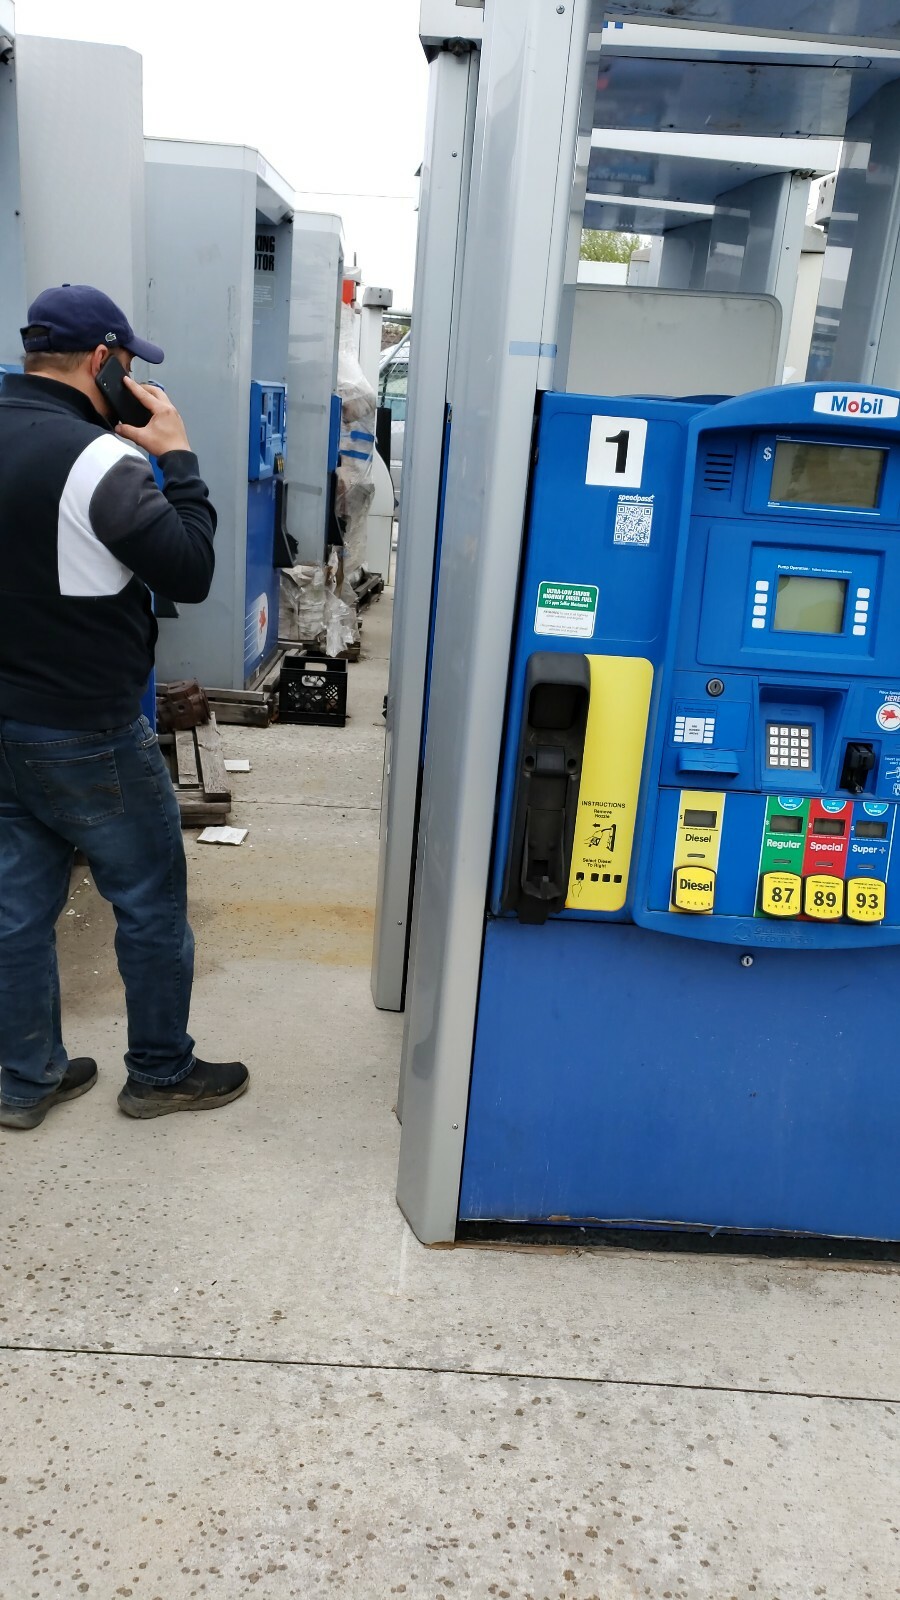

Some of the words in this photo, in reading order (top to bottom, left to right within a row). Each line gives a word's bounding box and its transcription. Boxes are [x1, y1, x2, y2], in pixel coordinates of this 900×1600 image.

[831, 395, 883, 414] Mobil
[606, 430, 629, 473] 1
[763, 446, 772, 461] $
[581, 800, 626, 808] INSTRUCTIONS
[685, 833, 712, 843] Diesel
[766, 839, 801, 849] Regular
[810, 842, 843, 852] Special
[852, 845, 877, 854] Super
[680, 878, 713, 892] Diesel
[772, 887, 795, 903] 87
[814, 891, 837, 908] 89
[856, 893, 879, 909] 93
